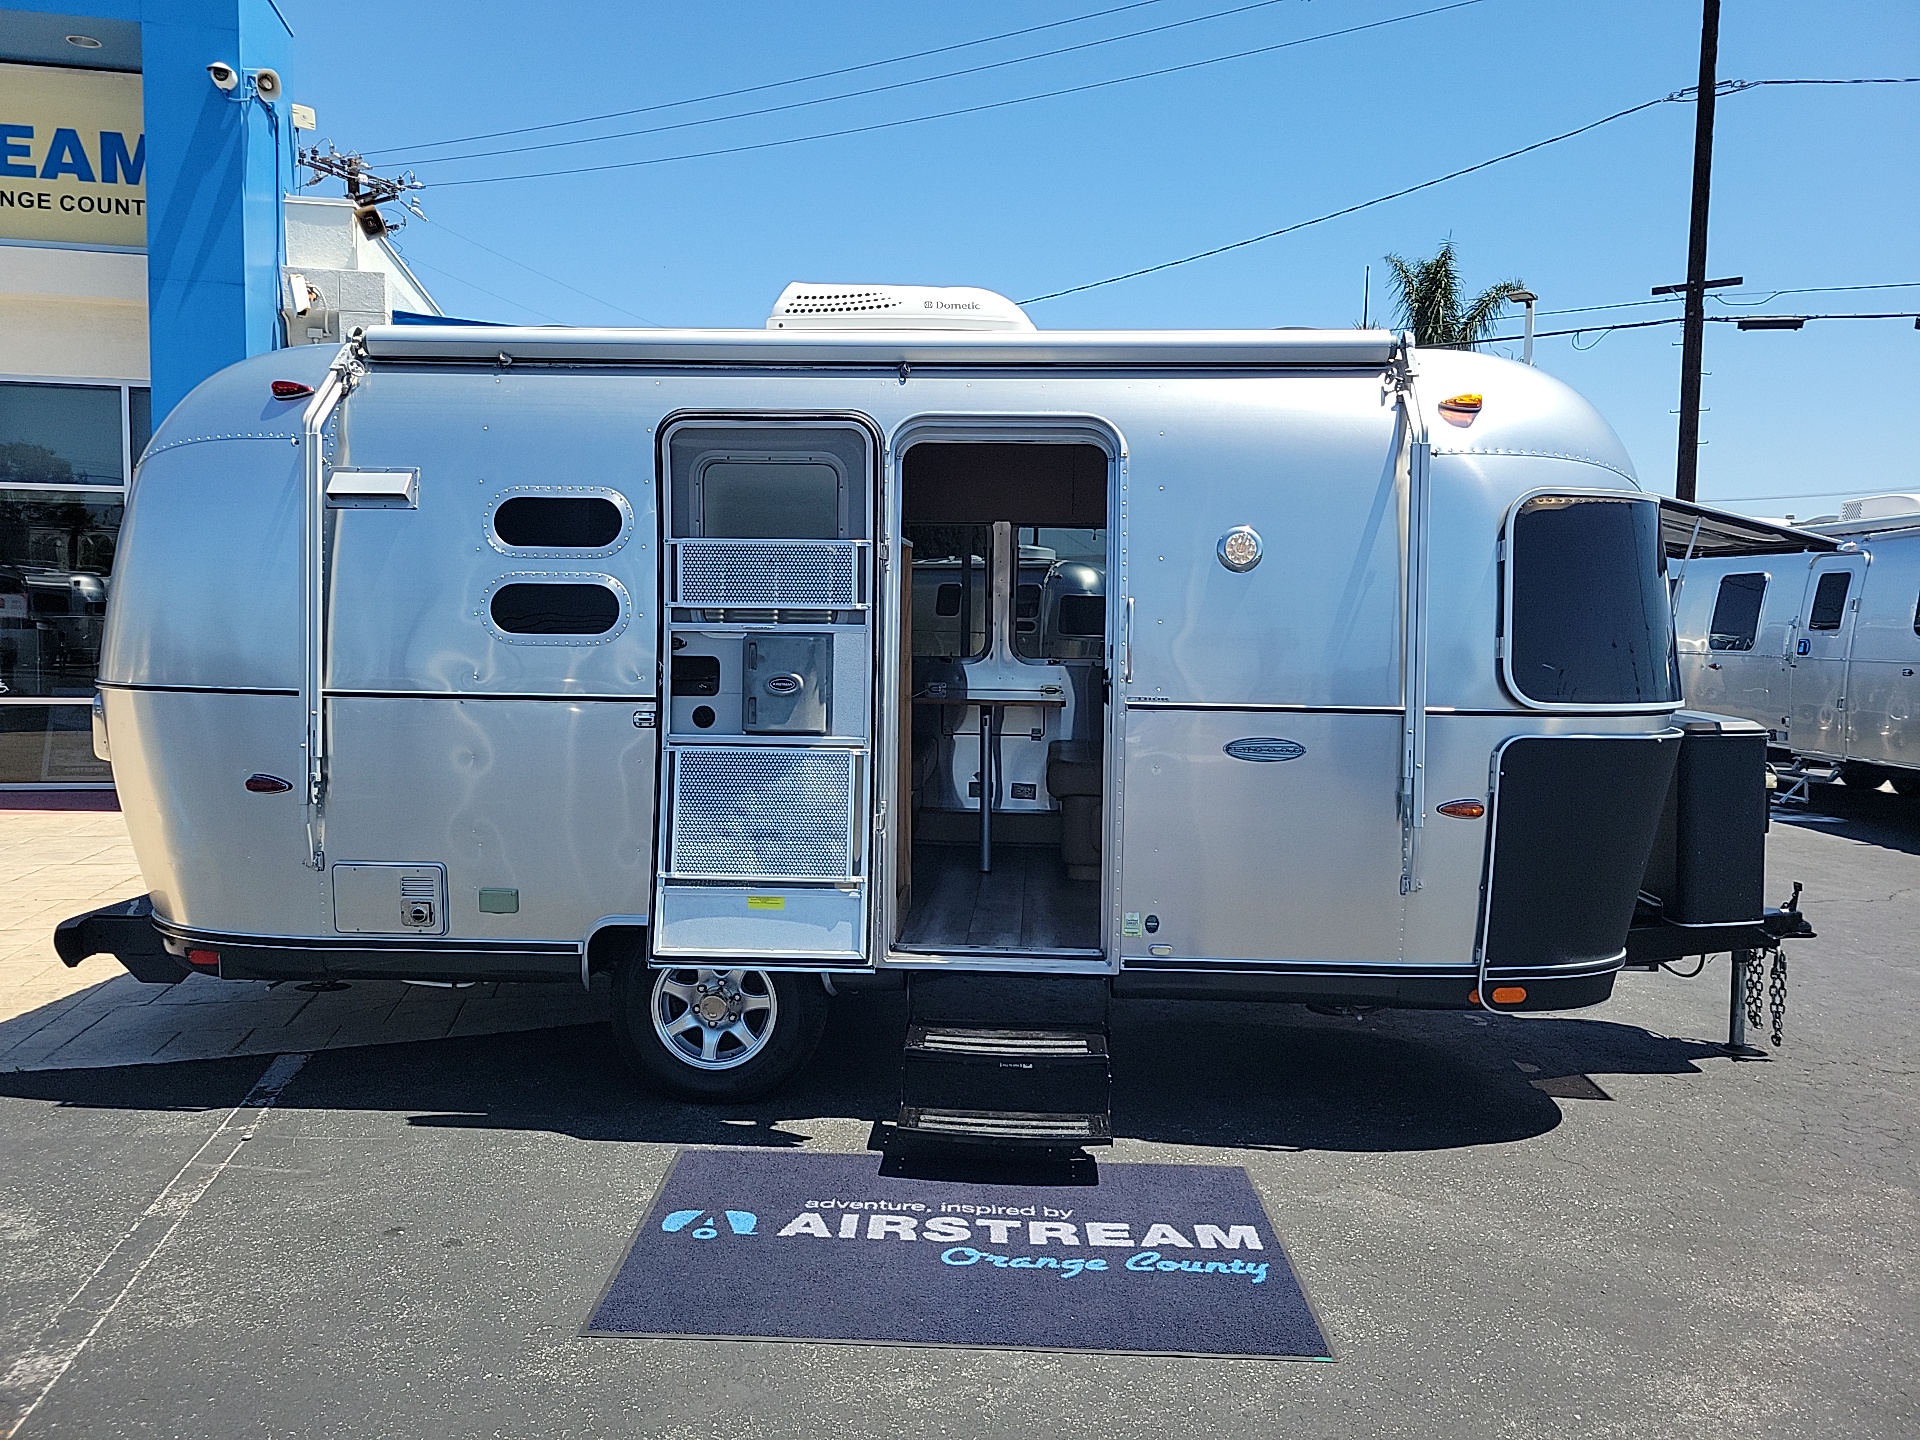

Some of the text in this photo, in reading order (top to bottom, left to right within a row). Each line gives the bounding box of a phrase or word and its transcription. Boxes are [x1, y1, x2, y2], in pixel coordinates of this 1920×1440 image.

[936, 301, 981, 310] Dometic
[804, 1199, 1074, 1220] adventure, inspired by
[776, 1212, 1264, 1250] AIRSTREAM
[940, 1247, 1270, 1284] Orange County
